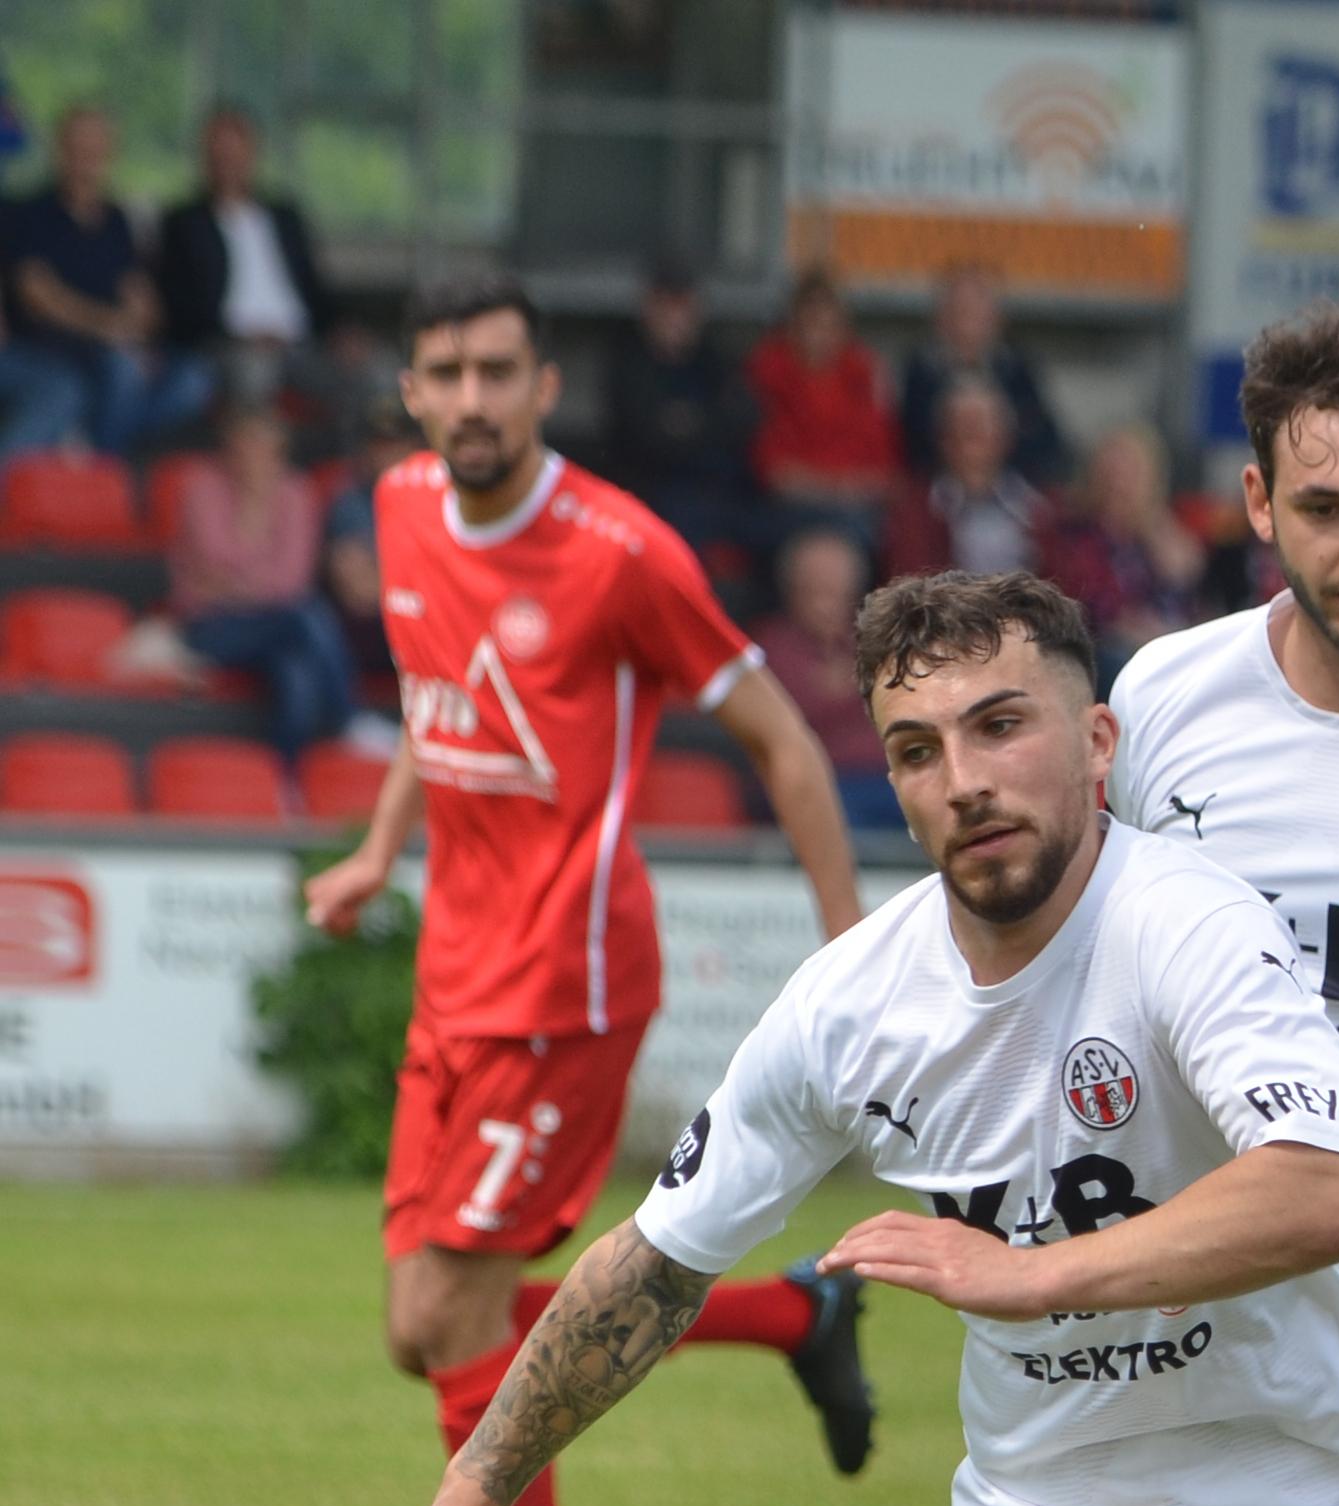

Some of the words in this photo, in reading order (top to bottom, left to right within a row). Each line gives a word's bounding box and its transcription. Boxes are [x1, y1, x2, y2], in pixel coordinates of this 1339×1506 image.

[1244, 1081, 1338, 1122] FREY
[477, 1117, 525, 1210] 7
[1011, 1321, 1212, 1385] ELEKTRO
